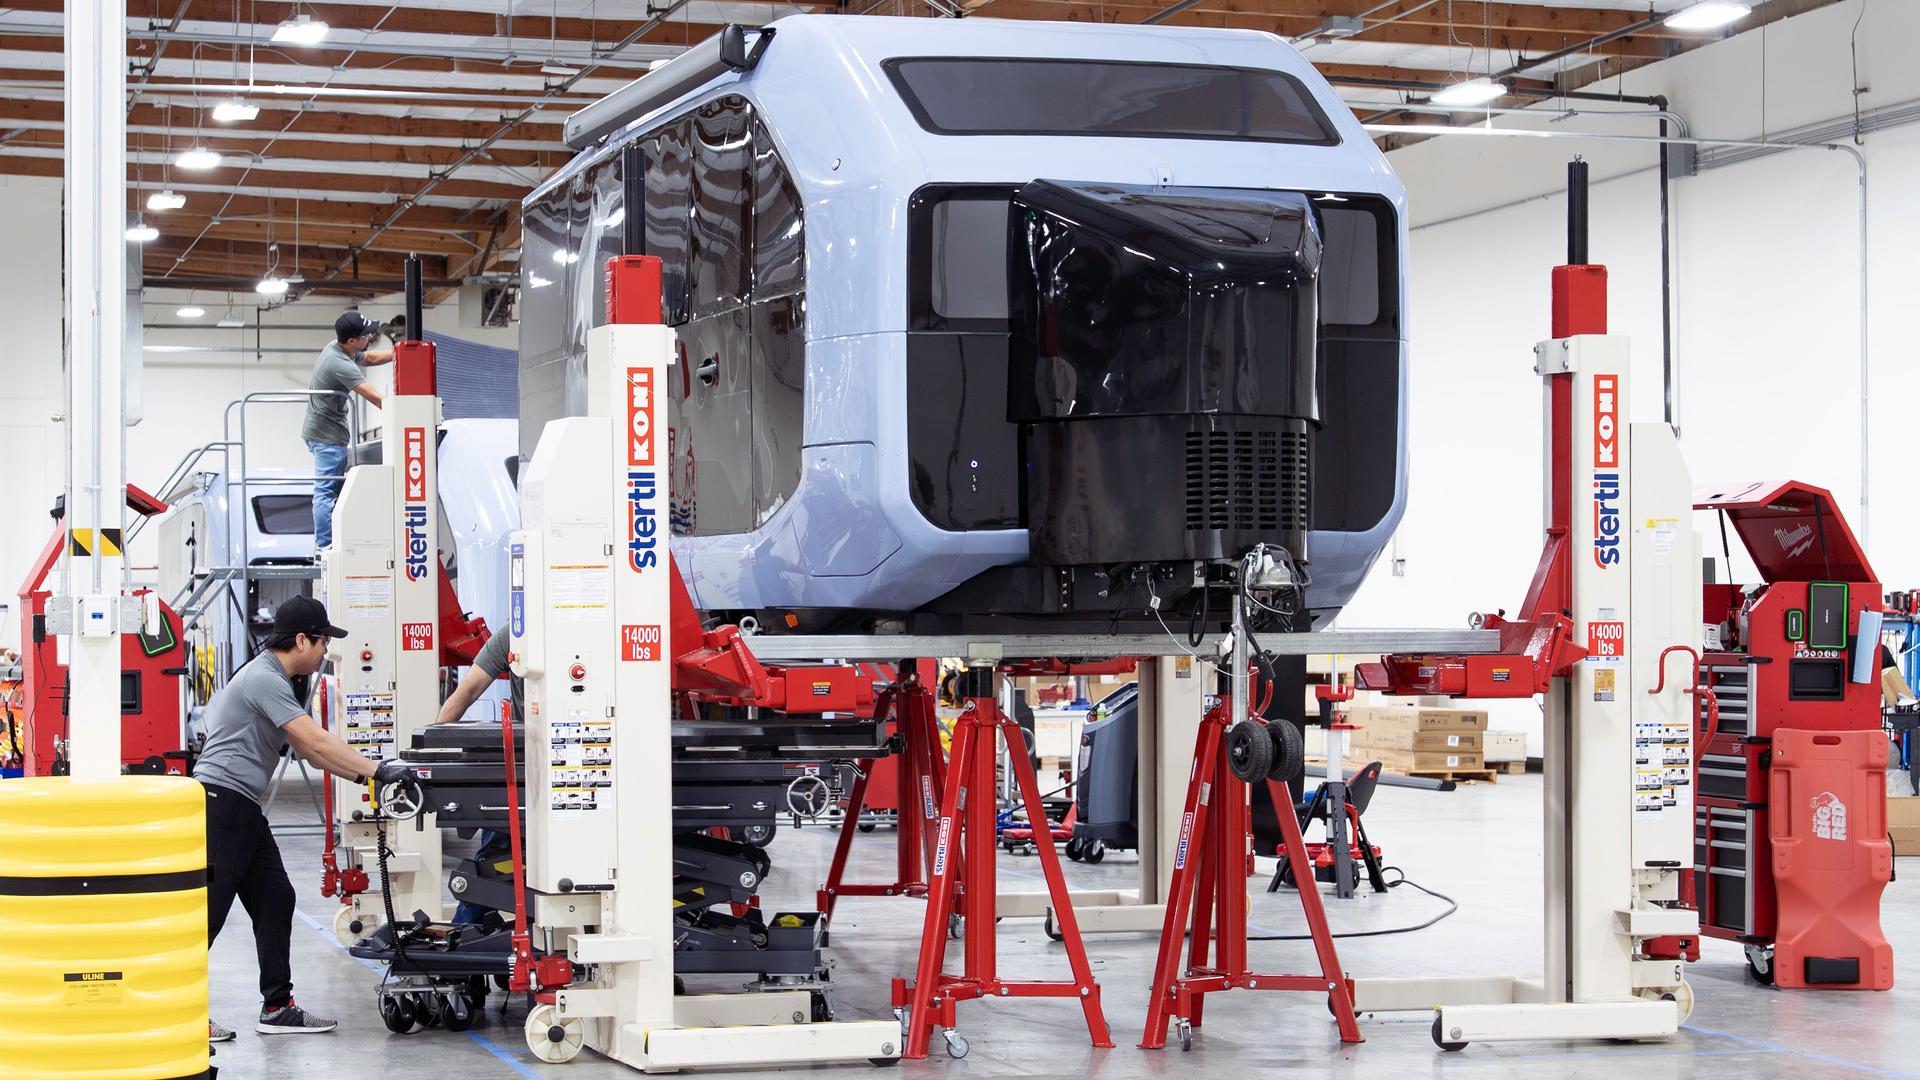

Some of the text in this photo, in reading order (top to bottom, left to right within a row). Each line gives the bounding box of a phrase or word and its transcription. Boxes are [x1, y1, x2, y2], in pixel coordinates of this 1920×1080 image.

[627, 372, 656, 573] stertil KONI
[1594, 379, 1619, 569] stertil KONI
[404, 431, 427, 582] stertil KONI
[404, 625, 431, 637] 14000
[410, 637, 425, 649] lbs
[624, 627, 659, 643] 14000
[1590, 624, 1623, 639] 14000
[632, 643, 651, 660] lbs
[1597, 639, 1615, 655] lbs
[1816, 806, 1832, 839] BIG
[1831, 804, 1847, 841] RED
[1177, 814, 1191, 867] stertil KONI
[936, 847, 945, 873] stertil
